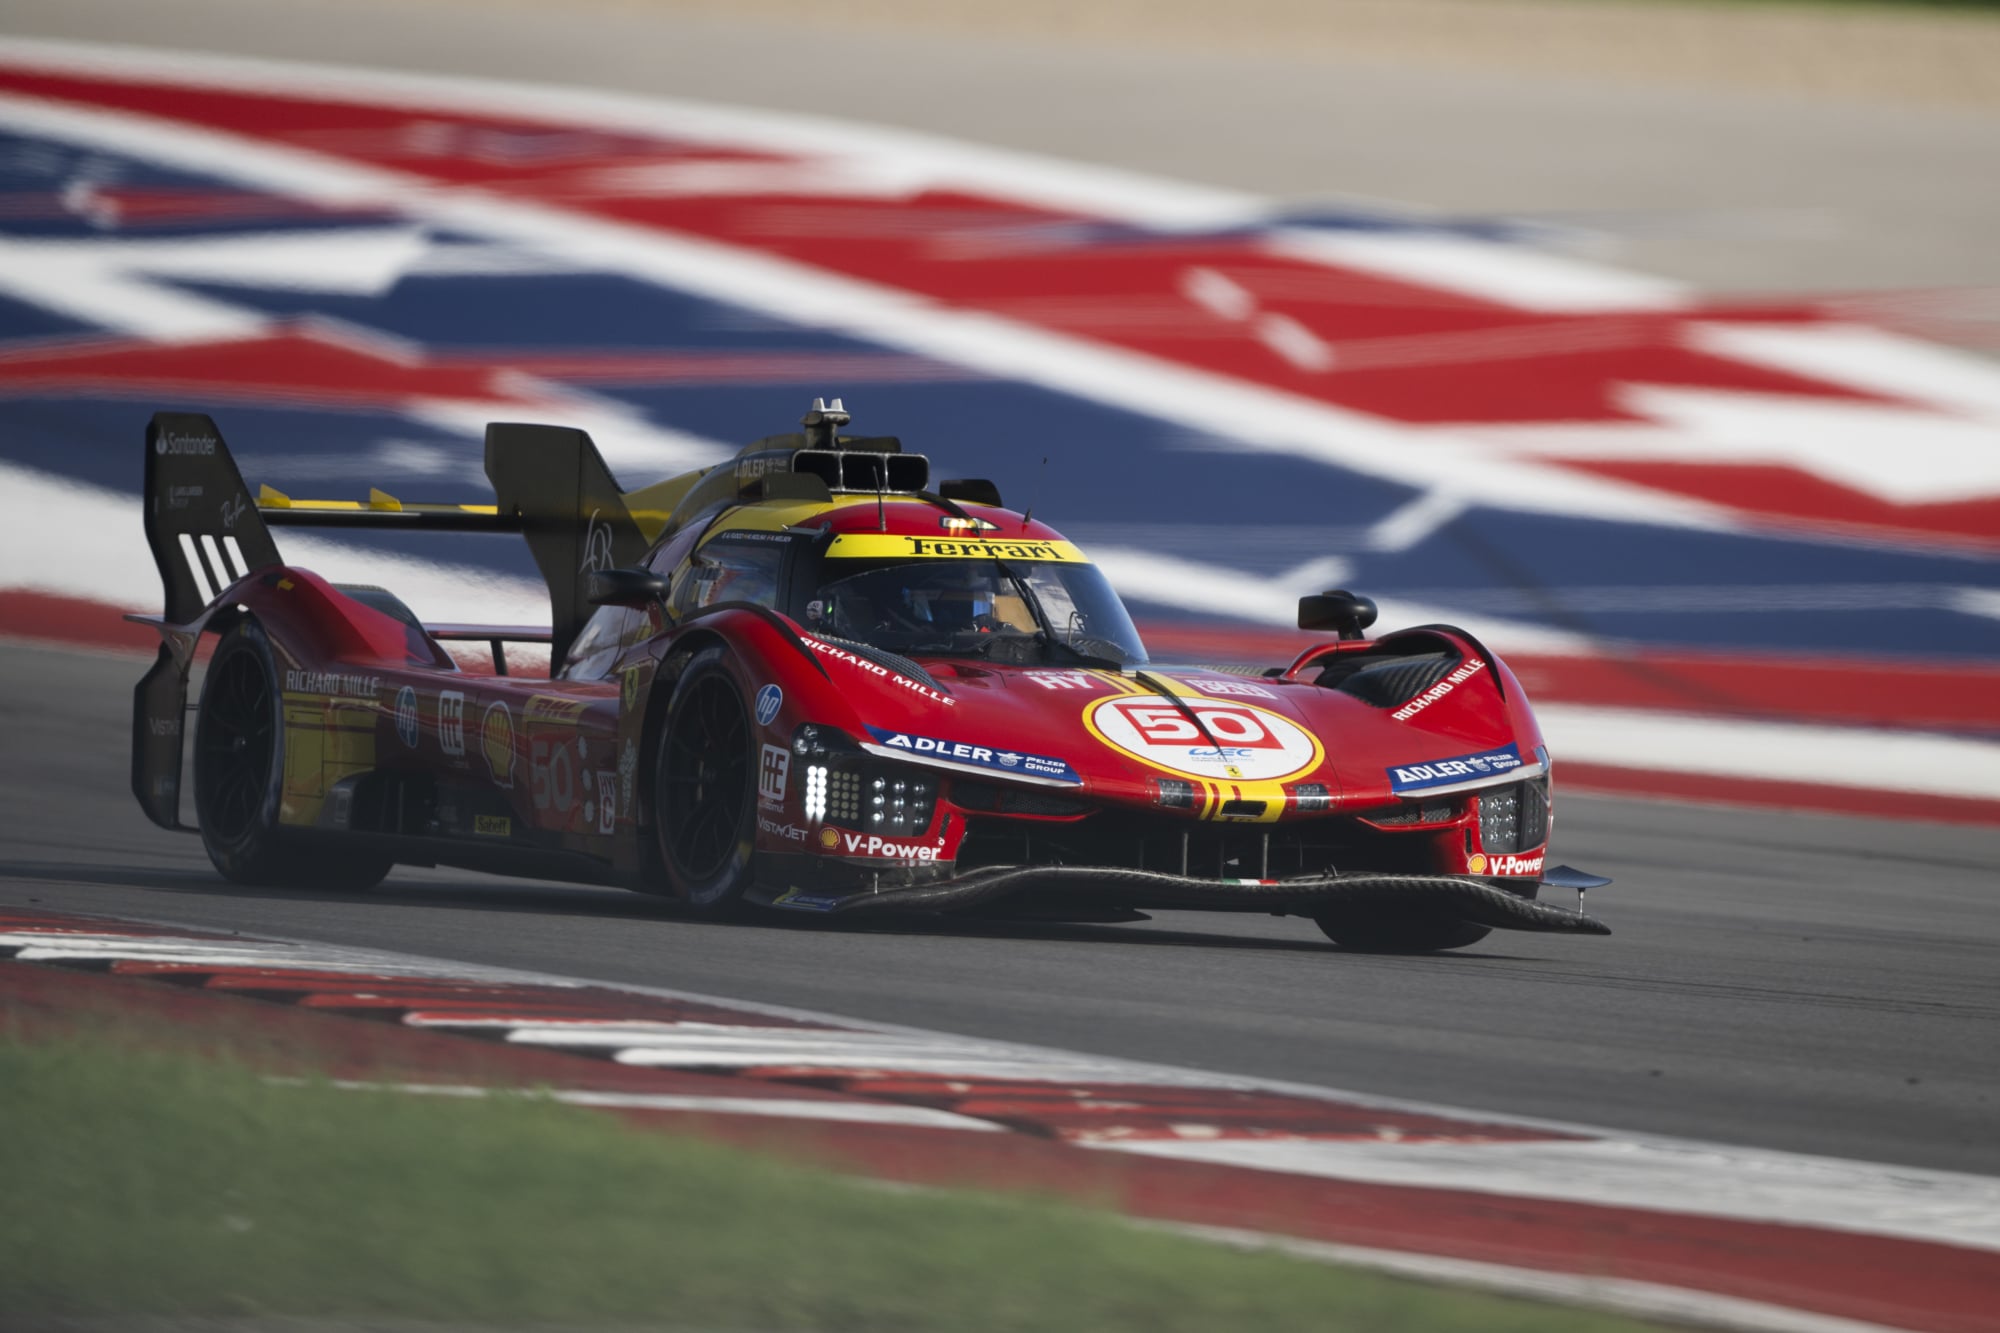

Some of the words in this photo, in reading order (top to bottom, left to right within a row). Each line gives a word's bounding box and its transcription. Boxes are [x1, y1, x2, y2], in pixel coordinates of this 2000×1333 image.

[168, 432, 216, 455] Santander
[904, 536, 1064, 559] Ferrari
[286, 670, 340, 694] RICHARD
[343, 674, 380, 697] MILLE
[800, 636, 888, 676] RICHARD
[893, 675, 956, 706] MILLE
[1392, 681, 1454, 721] RICHARD
[1447, 658, 1486, 685] MILLE
[757, 685, 780, 724] hp
[1126, 708, 1265, 743] 50
[885, 733, 993, 762] ADLER
[1188, 747, 1253, 757] WEC
[1025, 762, 1065, 774] GROUP
[1026, 756, 1066, 768] PELZER
[1394, 761, 1475, 784] ADLER
[531, 740, 573, 812] 50
[844, 833, 942, 861] V-Power
[1490, 856, 1544, 876] V-Power
